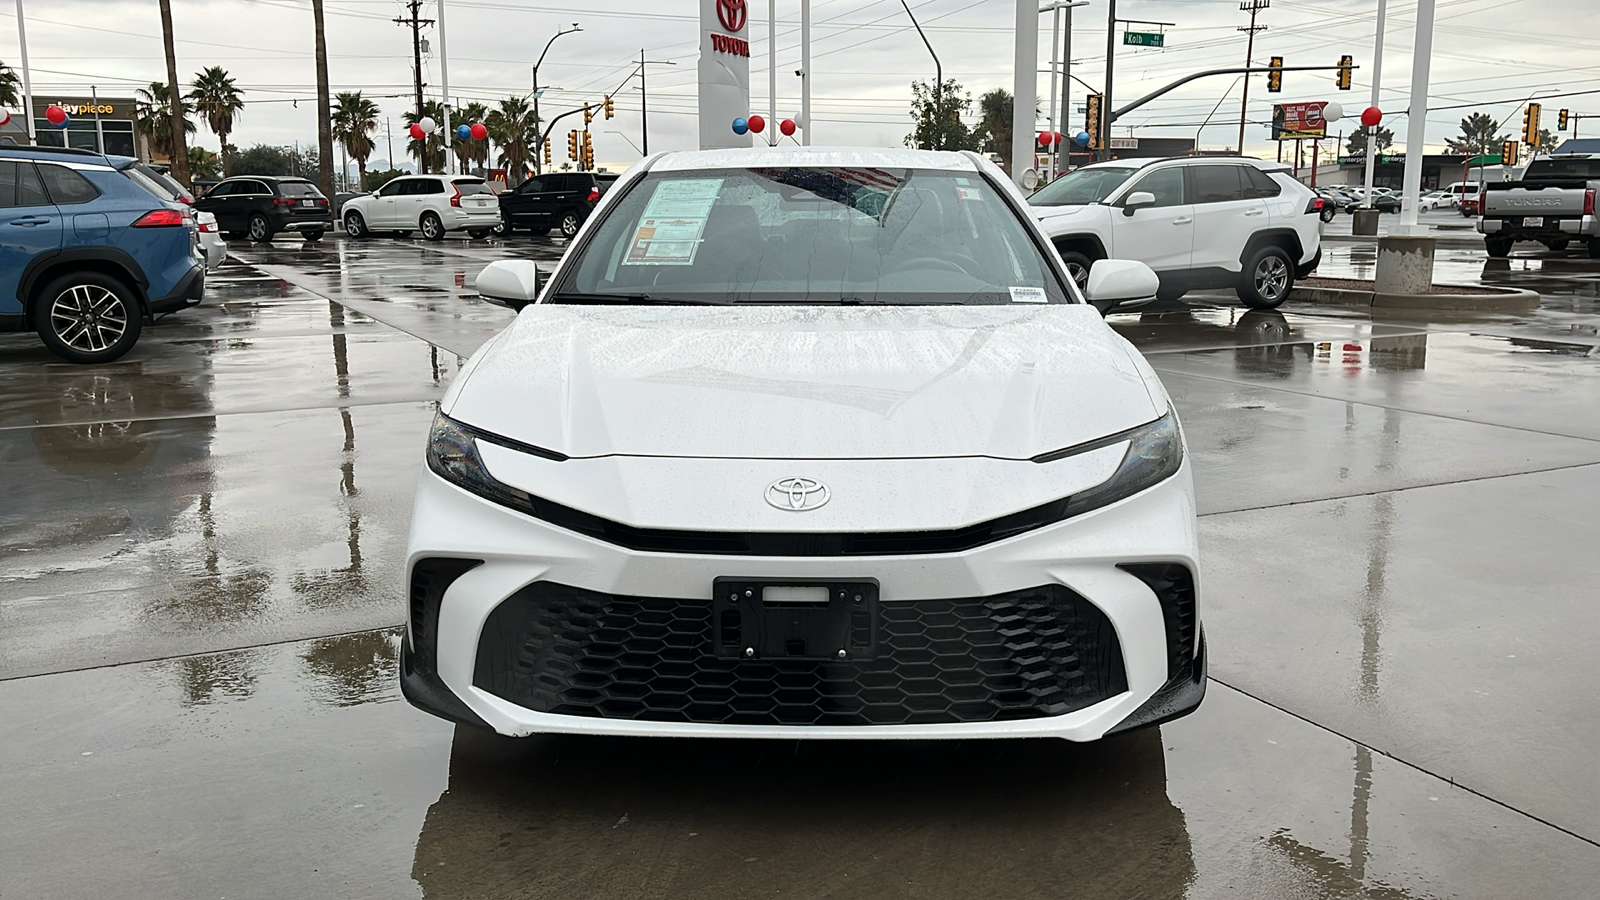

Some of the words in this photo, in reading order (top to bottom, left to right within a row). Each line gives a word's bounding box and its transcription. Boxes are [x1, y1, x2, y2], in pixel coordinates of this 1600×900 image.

[1128, 33, 1143, 44] Kolb
[710, 34, 750, 58] TOYOTA
[1504, 197, 1562, 206] TUNDRA
